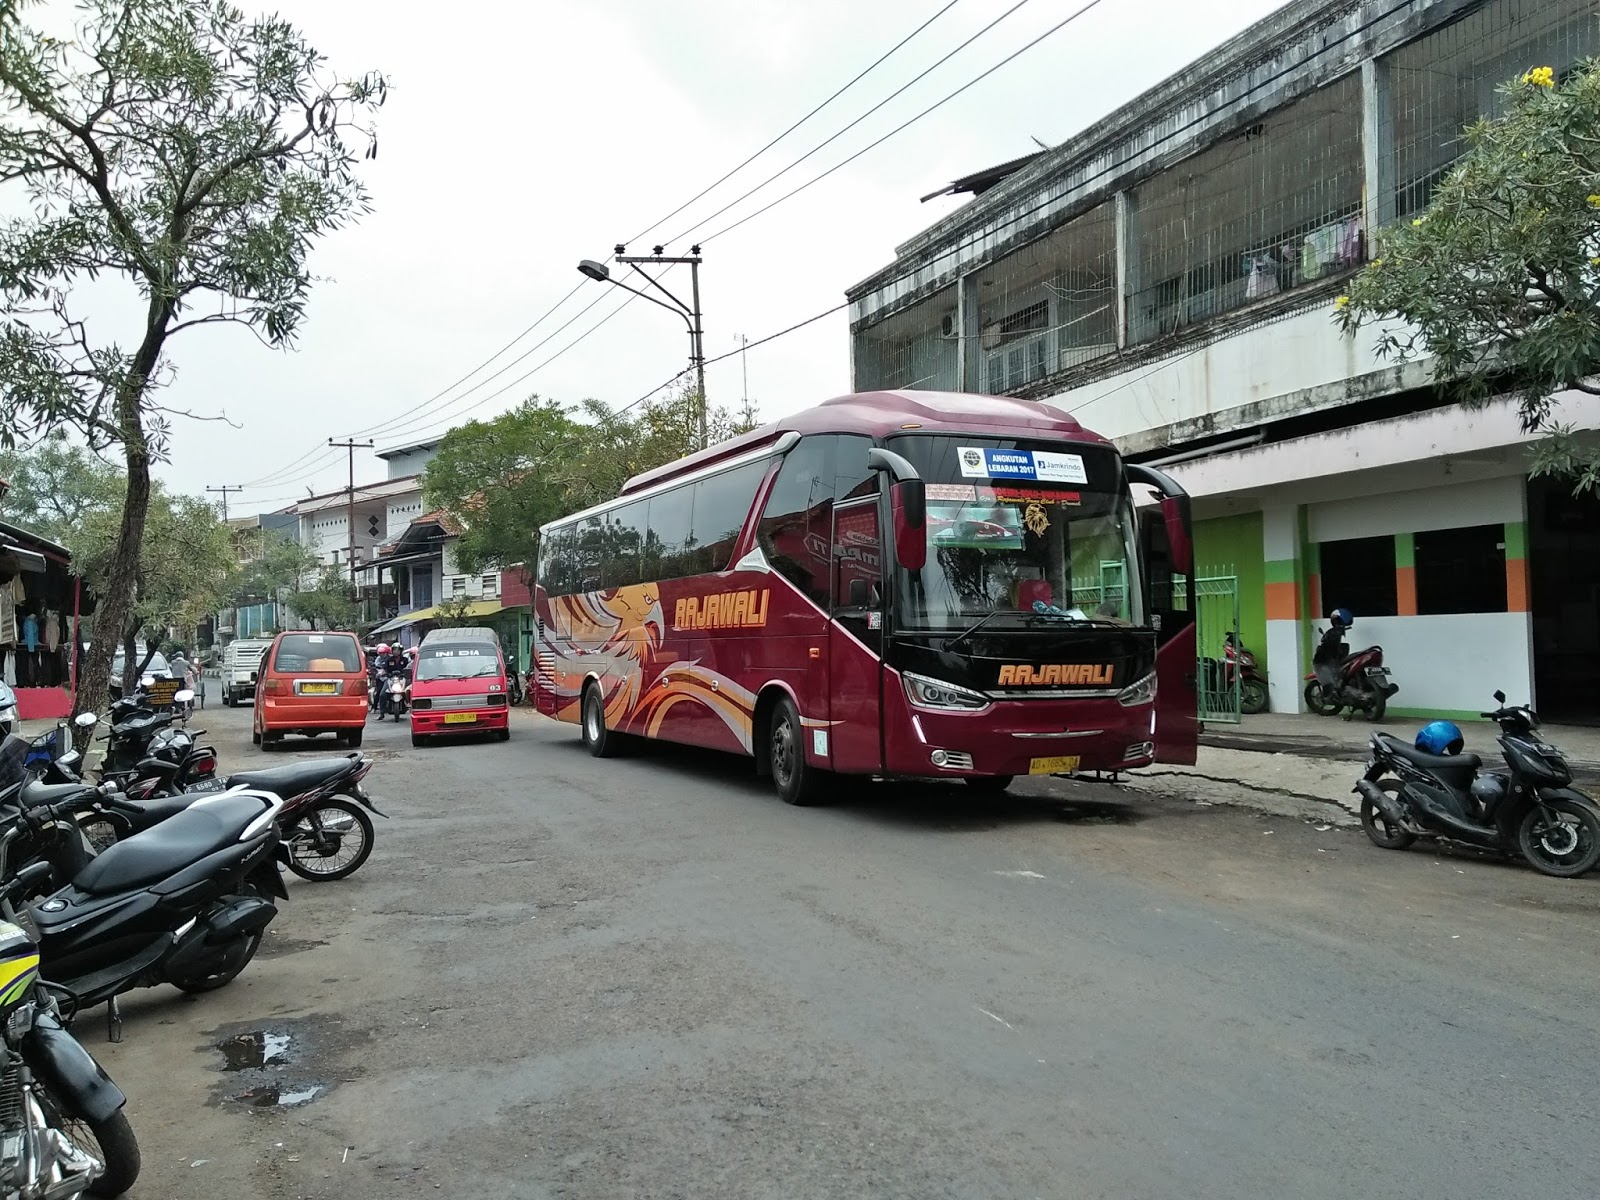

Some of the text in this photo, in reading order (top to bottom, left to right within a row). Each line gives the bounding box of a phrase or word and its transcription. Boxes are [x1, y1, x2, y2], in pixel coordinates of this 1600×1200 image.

[992, 454, 1028, 464] ANGKUTAN
[988, 464, 1019, 473] LEBARAN
[1019, 465, 1035, 475] 2017
[1046, 461, 1082, 471] Jamkrindo
[674, 588, 770, 631] RAJAWALI
[997, 664, 1114, 686] RAJAWALI
[157, 681, 180, 689] COLLECTION
